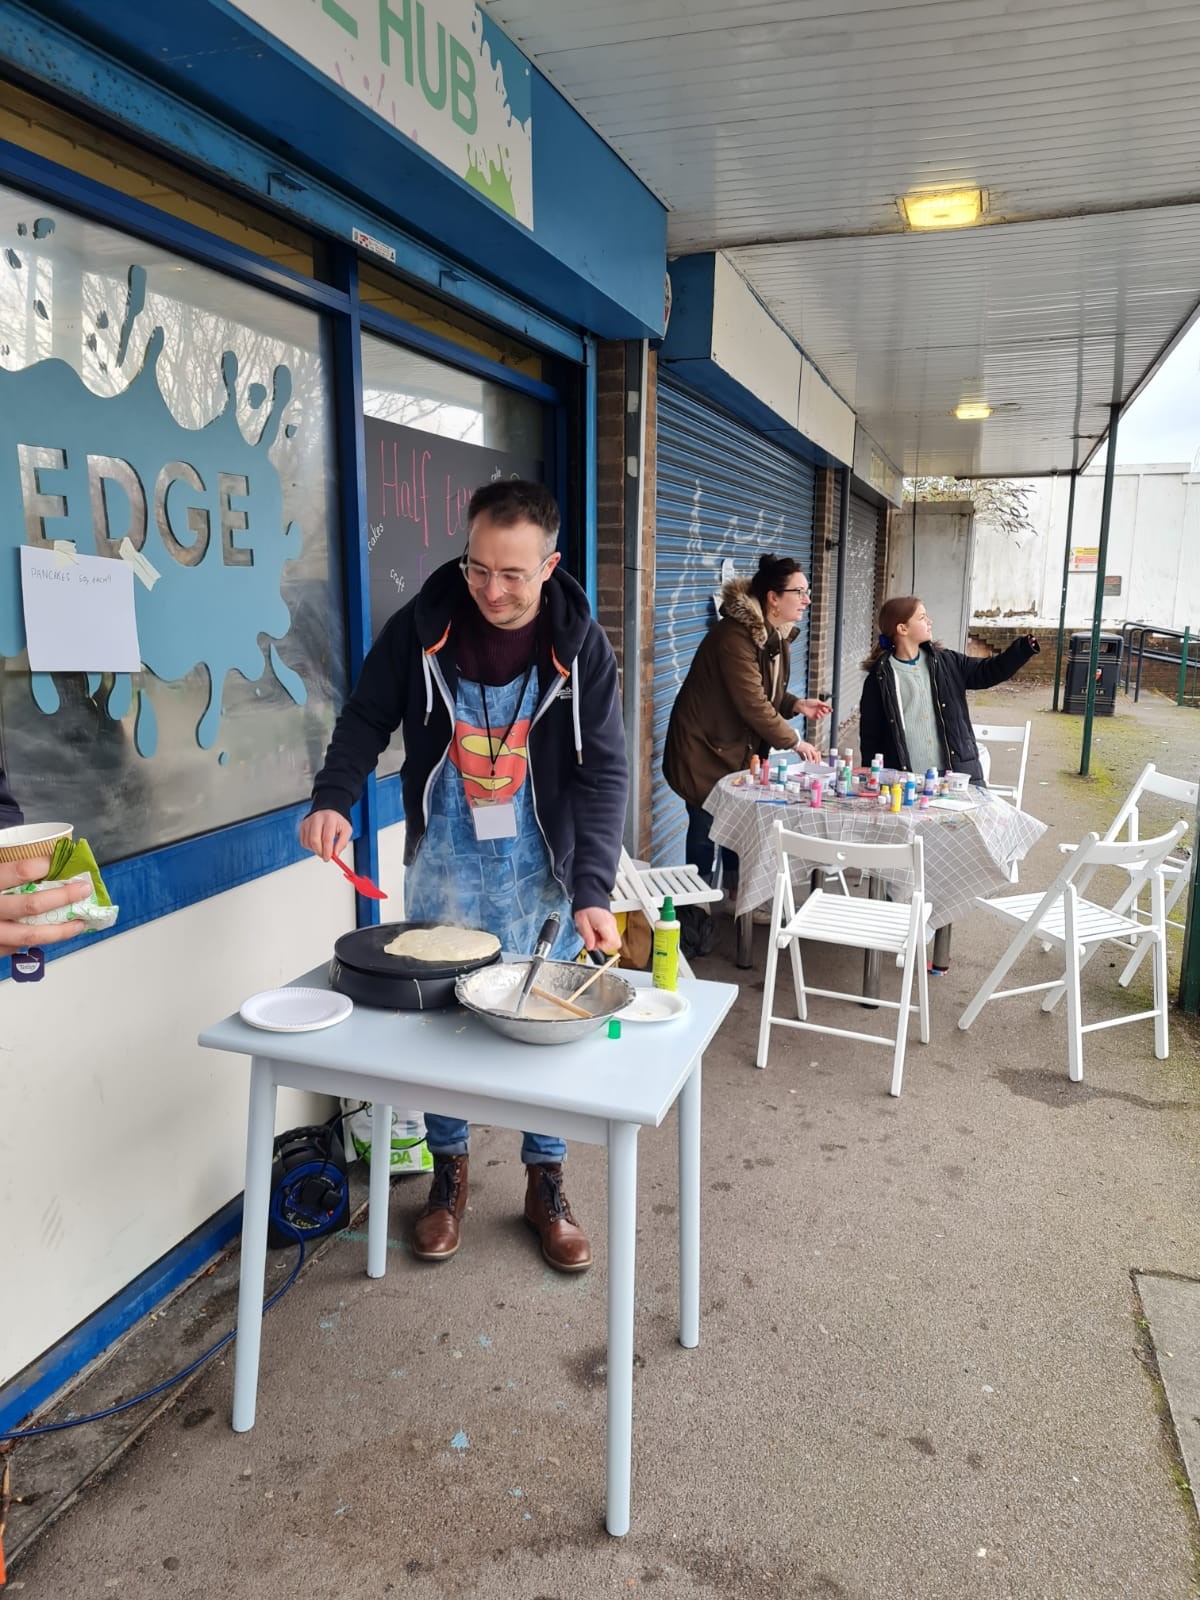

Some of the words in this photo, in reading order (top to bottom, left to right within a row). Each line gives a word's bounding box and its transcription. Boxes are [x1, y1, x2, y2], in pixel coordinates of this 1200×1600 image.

[379, 0, 478, 135] HUB
[17, 443, 254, 567] EDGE
[367, 523, 384, 553] cakes
[380, 439, 431, 548] Half
[445, 475, 473, 536] te
[390, 1151, 413, 1165] DA
